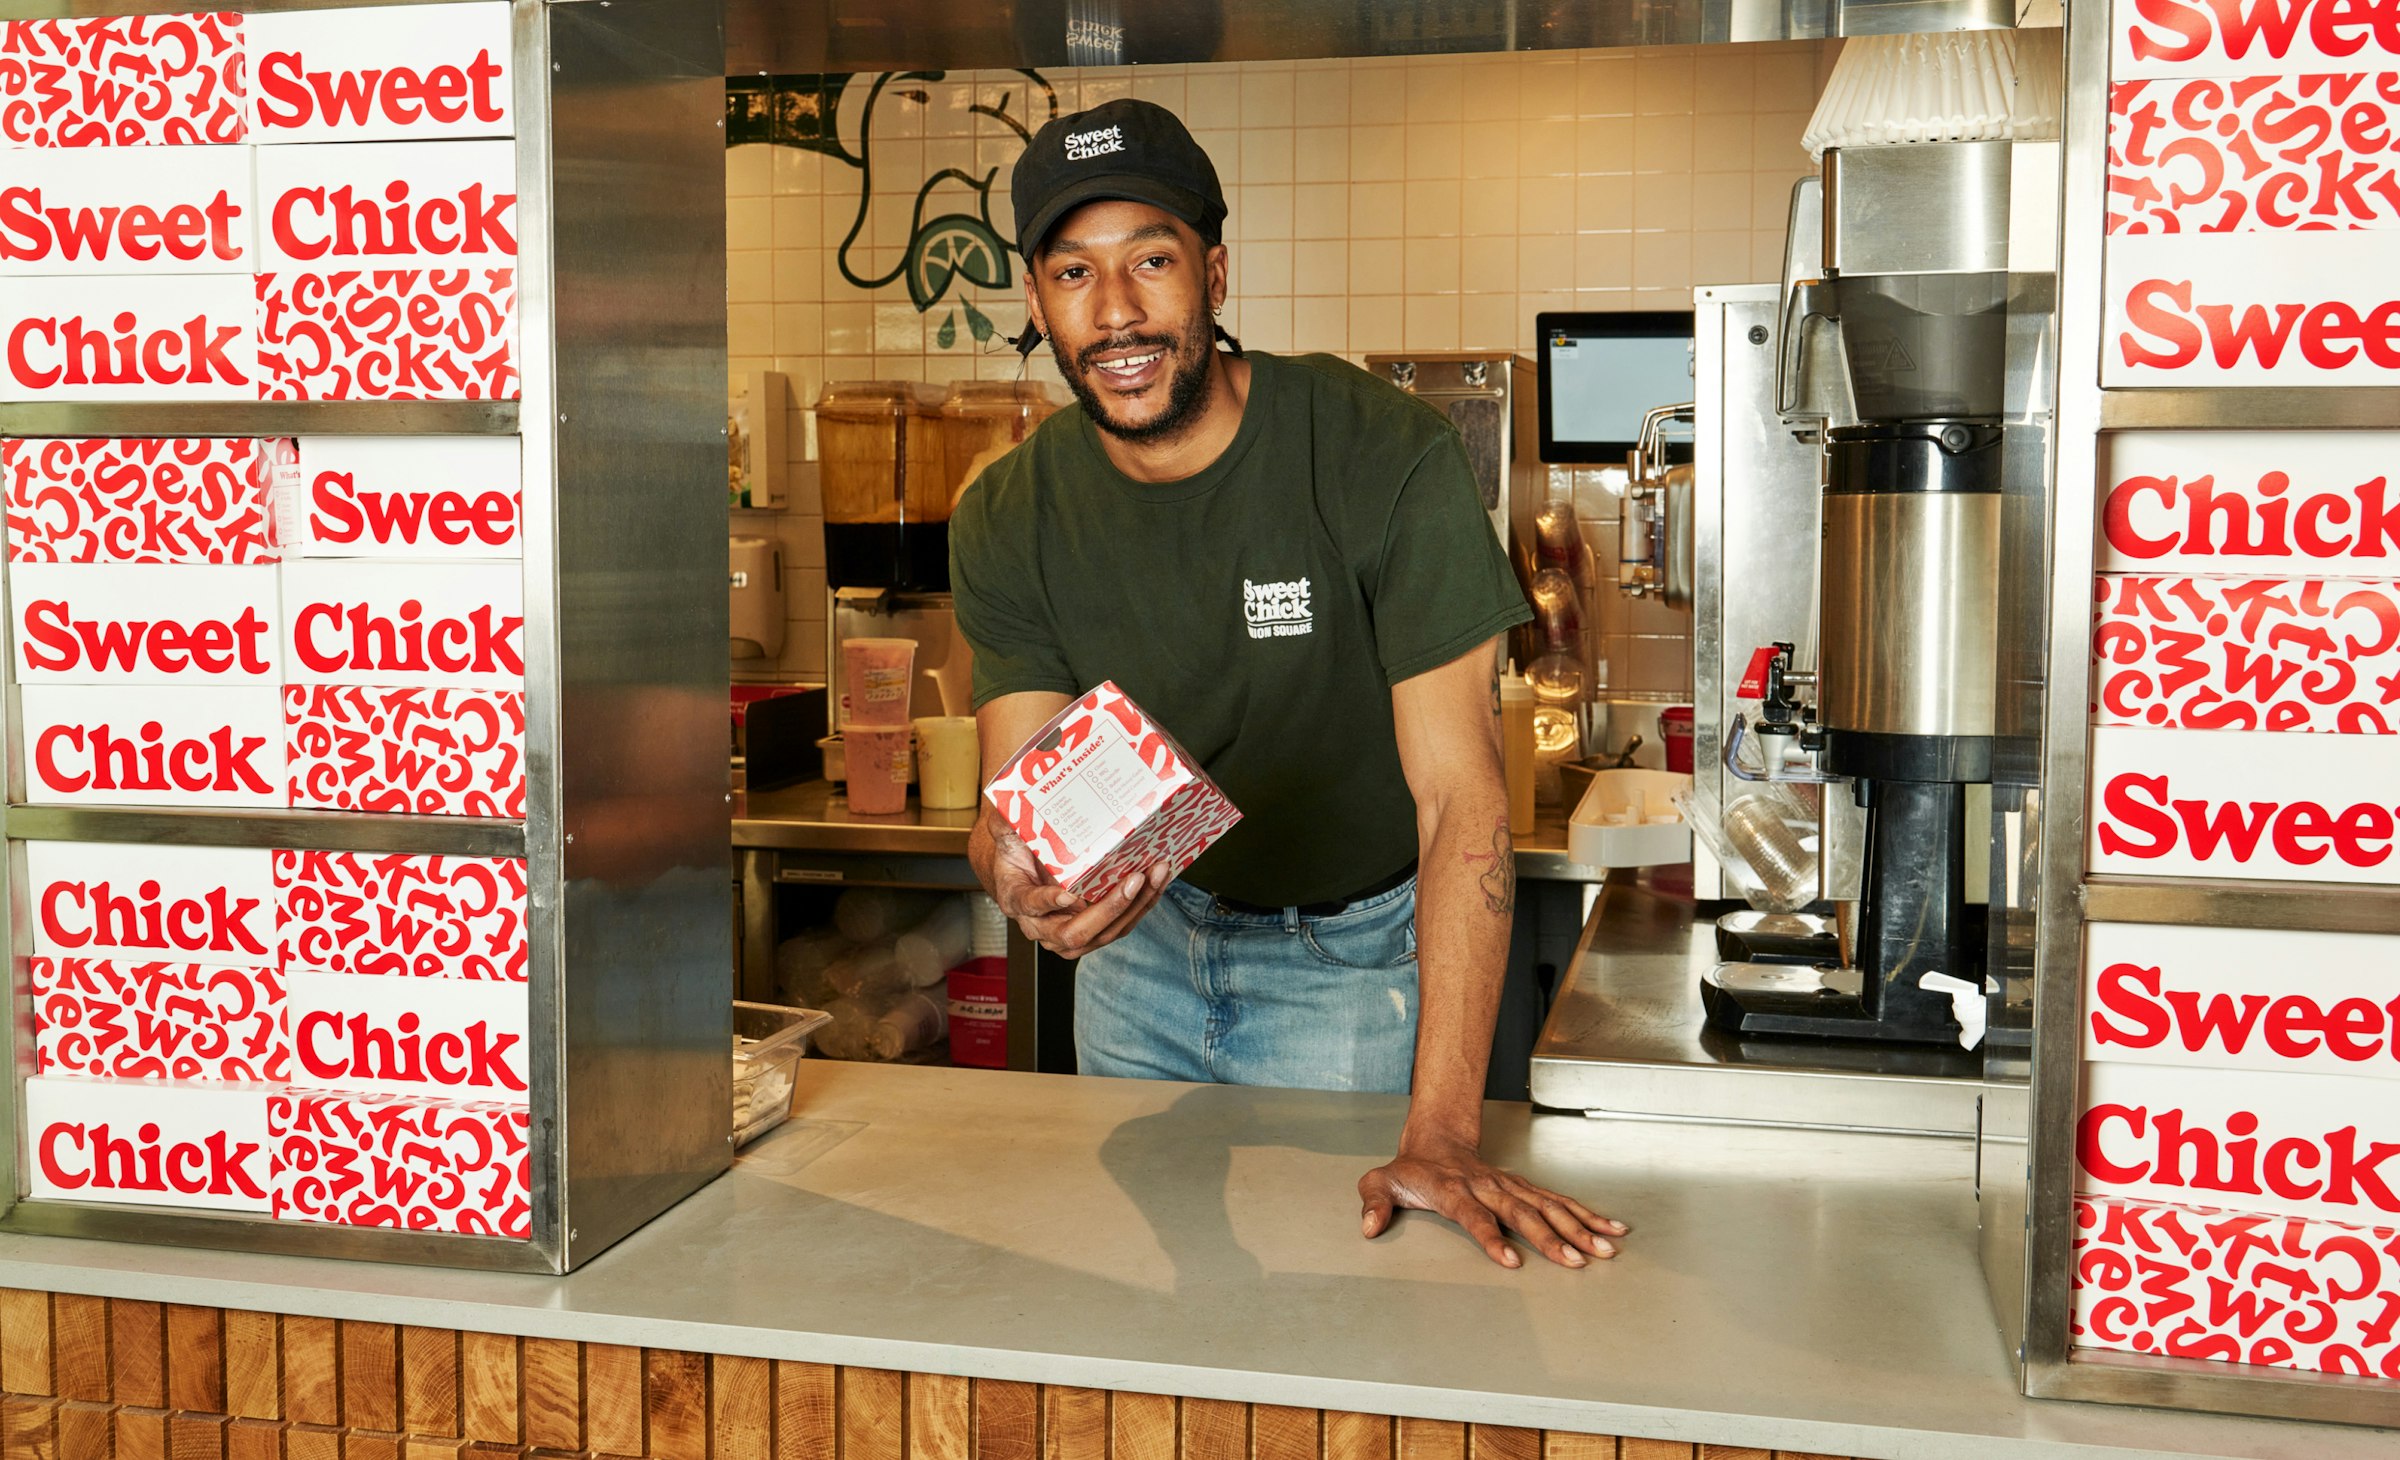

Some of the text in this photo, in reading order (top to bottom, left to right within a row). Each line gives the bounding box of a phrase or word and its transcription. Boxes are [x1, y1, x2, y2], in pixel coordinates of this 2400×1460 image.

[257, 49, 504, 128] Sweet
[1065, 125, 1122, 150] Sweet
[1067, 139, 1126, 160] Chick
[0, 187, 242, 261] Sweet
[272, 180, 518, 260] Chick
[8, 312, 249, 389] Chick
[310, 471, 522, 545] Swee
[2103, 472, 2400, 560] Chick
[1244, 577, 1311, 601] Sweet
[1244, 597, 1313, 622] Chick
[24, 600, 270, 674] Sweet
[294, 600, 523, 676] Chick
[1247, 622, 1313, 639] ION SQUARE
[36, 721, 274, 794] Chick
[1040, 766, 1073, 795] What's
[1072, 735, 1105, 767] Inside?
[2098, 773, 2400, 867] Swee
[41, 880, 267, 956] Chick
[296, 1011, 527, 1091] Chick
[39, 1122, 267, 1199] Chick
[2077, 1104, 2400, 1212] Chick
